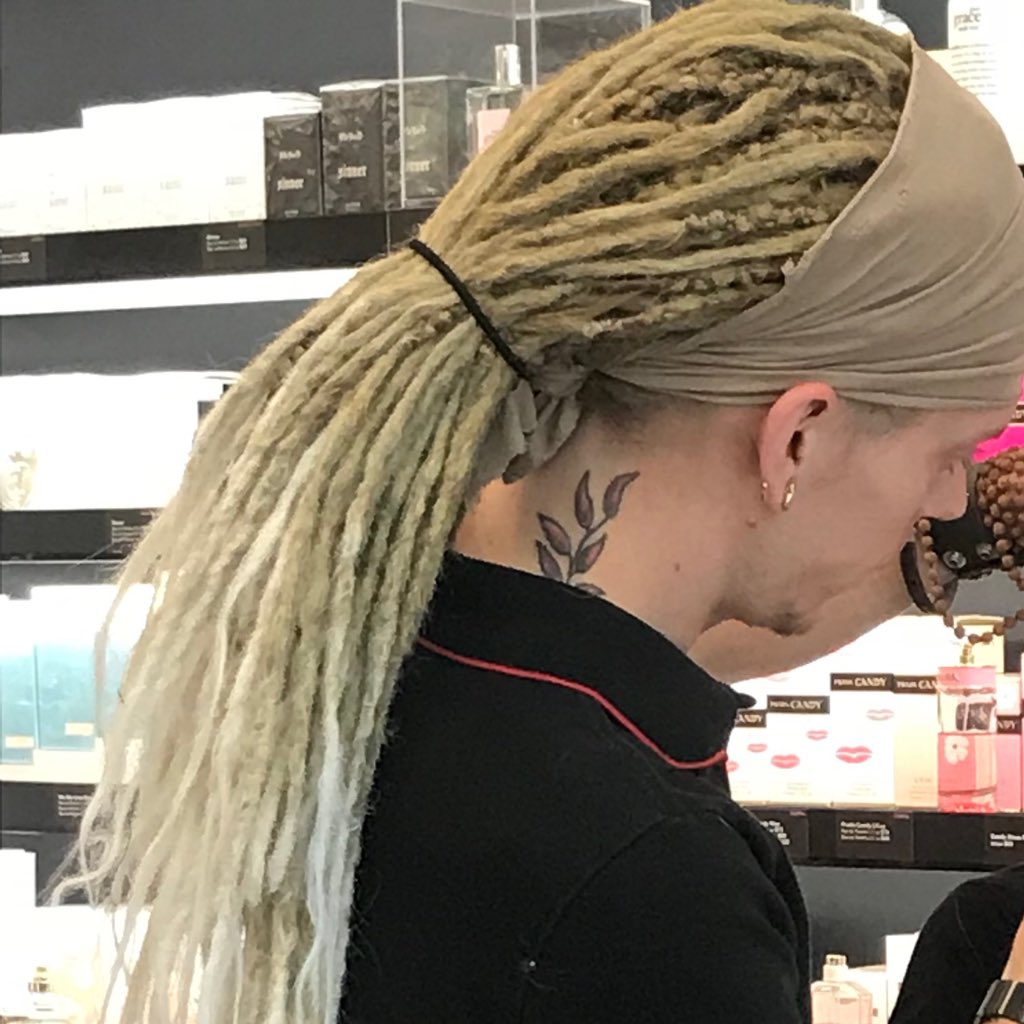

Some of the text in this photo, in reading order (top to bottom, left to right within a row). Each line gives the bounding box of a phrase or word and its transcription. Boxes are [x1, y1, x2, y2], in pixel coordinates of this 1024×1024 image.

[854, 676, 888, 688] CANDY
[789, 699, 824, 710] CANDY
[734, 711, 763, 723] ANDY
